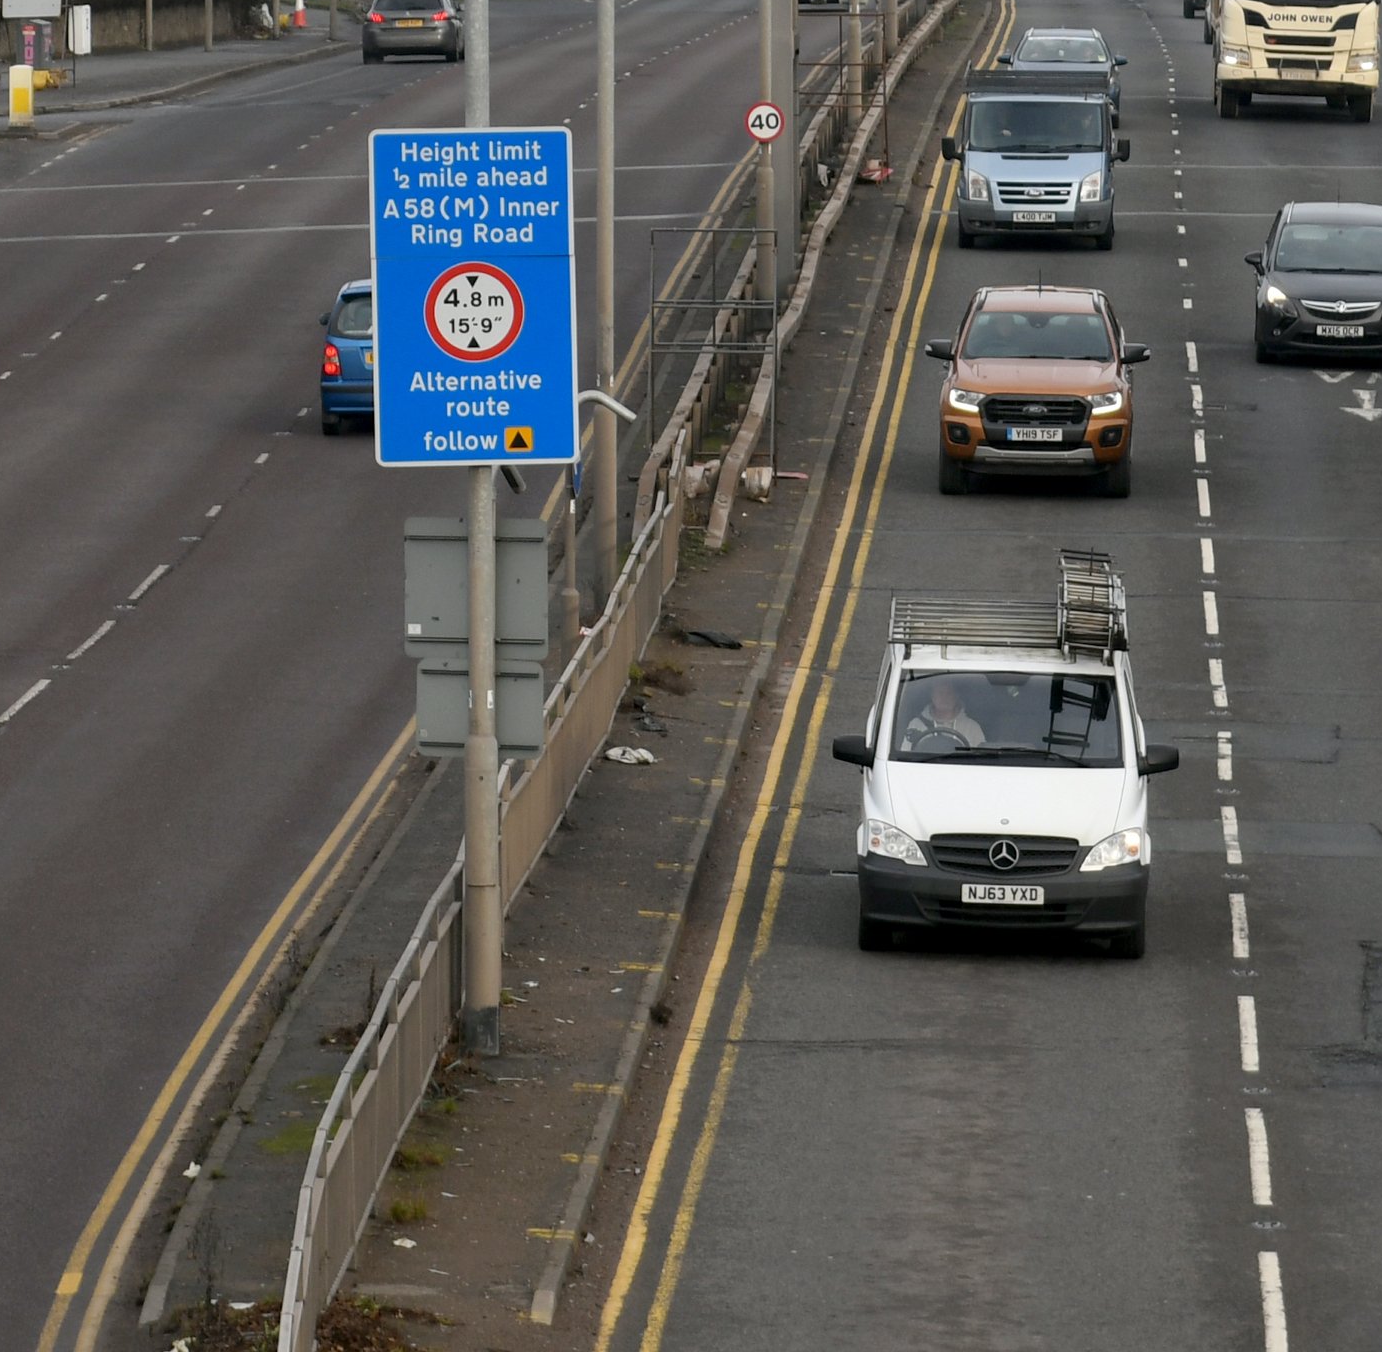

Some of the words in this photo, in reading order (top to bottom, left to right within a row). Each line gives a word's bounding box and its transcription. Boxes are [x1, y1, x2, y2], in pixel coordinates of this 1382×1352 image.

[1267, 13, 1297, 22] JOHN
[1301, 14, 1333, 23] OWEN
[750, 112, 779, 130] 40
[401, 141, 480, 165] Height
[489, 139, 541, 161] limit
[419, 167, 467, 188] mile
[477, 166, 547, 187] ahead
[500, 198, 559, 218] Inner
[412, 224, 463, 248] Ring
[474, 222, 534, 243] Road
[409, 370, 542, 392] Alternative
[446, 397, 510, 417] route
[423, 429, 498, 451] follow
[1015, 429, 1038, 439] YH19
[1040, 429, 1059, 439] TSF
[968, 886, 1005, 900] NJ63
[1010, 887, 1038, 901] YXD
